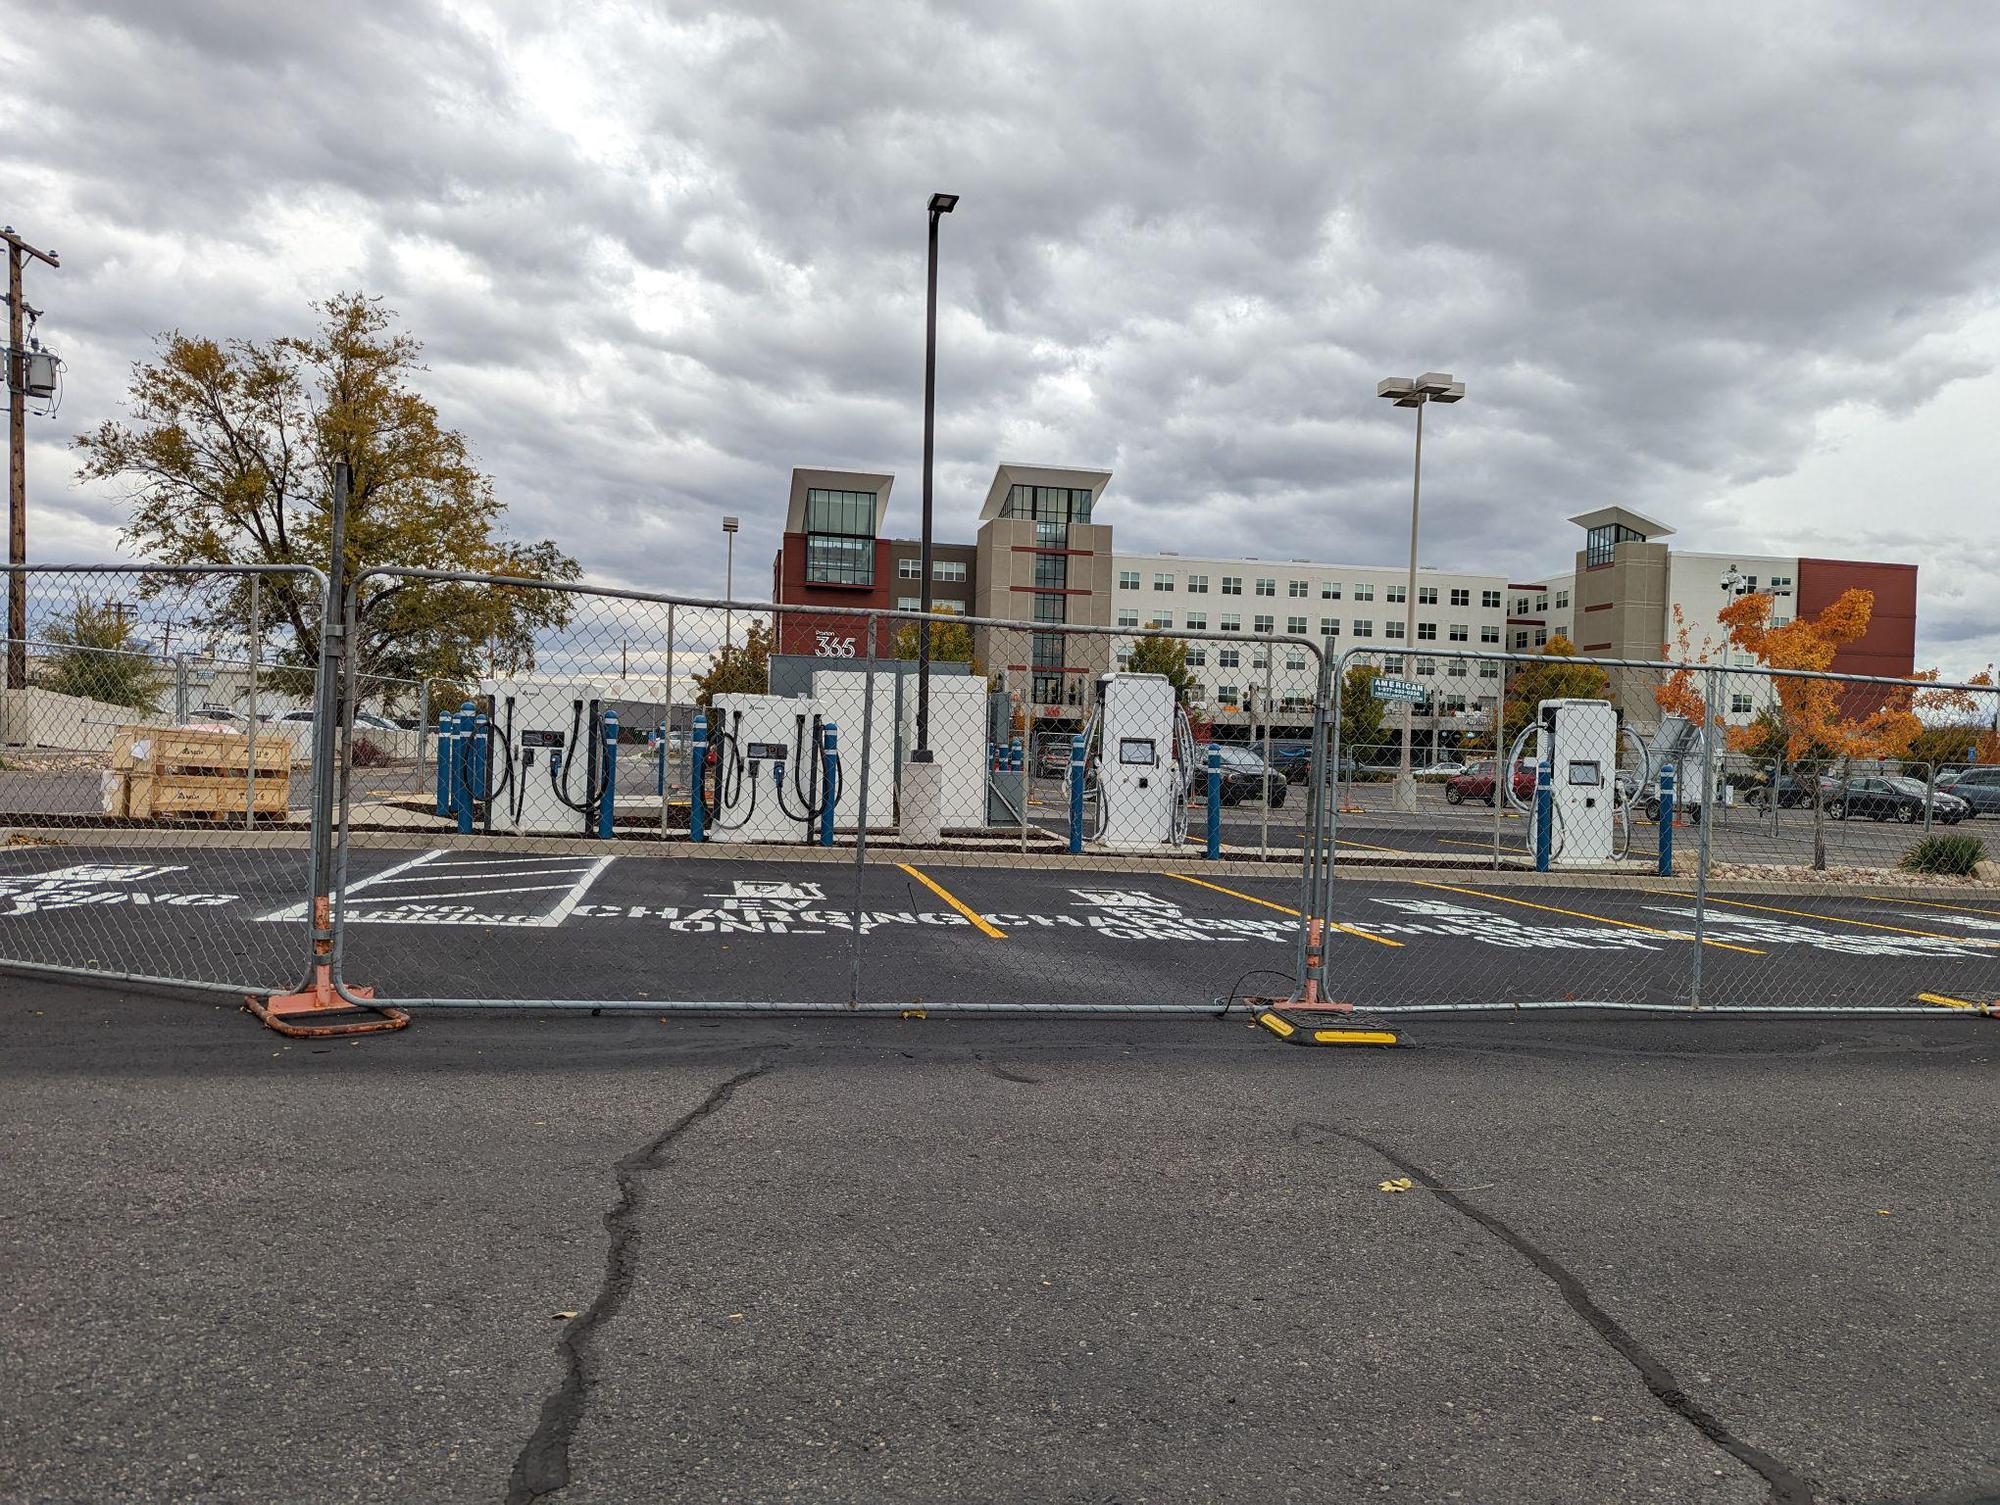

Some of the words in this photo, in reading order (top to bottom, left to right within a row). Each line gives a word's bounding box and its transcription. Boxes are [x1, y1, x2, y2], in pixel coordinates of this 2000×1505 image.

[815, 636, 856, 658] 365
[1374, 679, 1423, 691] AMERICAN
[396, 904, 475, 913] NO
[723, 898, 812, 911] EV
[329, 910, 541, 923] ARKING
[571, 904, 971, 926] CHARGING
[1099, 906, 1183, 919] EV
[669, 920, 880, 935] ONLY
[1097, 927, 1289, 943] ONLY
